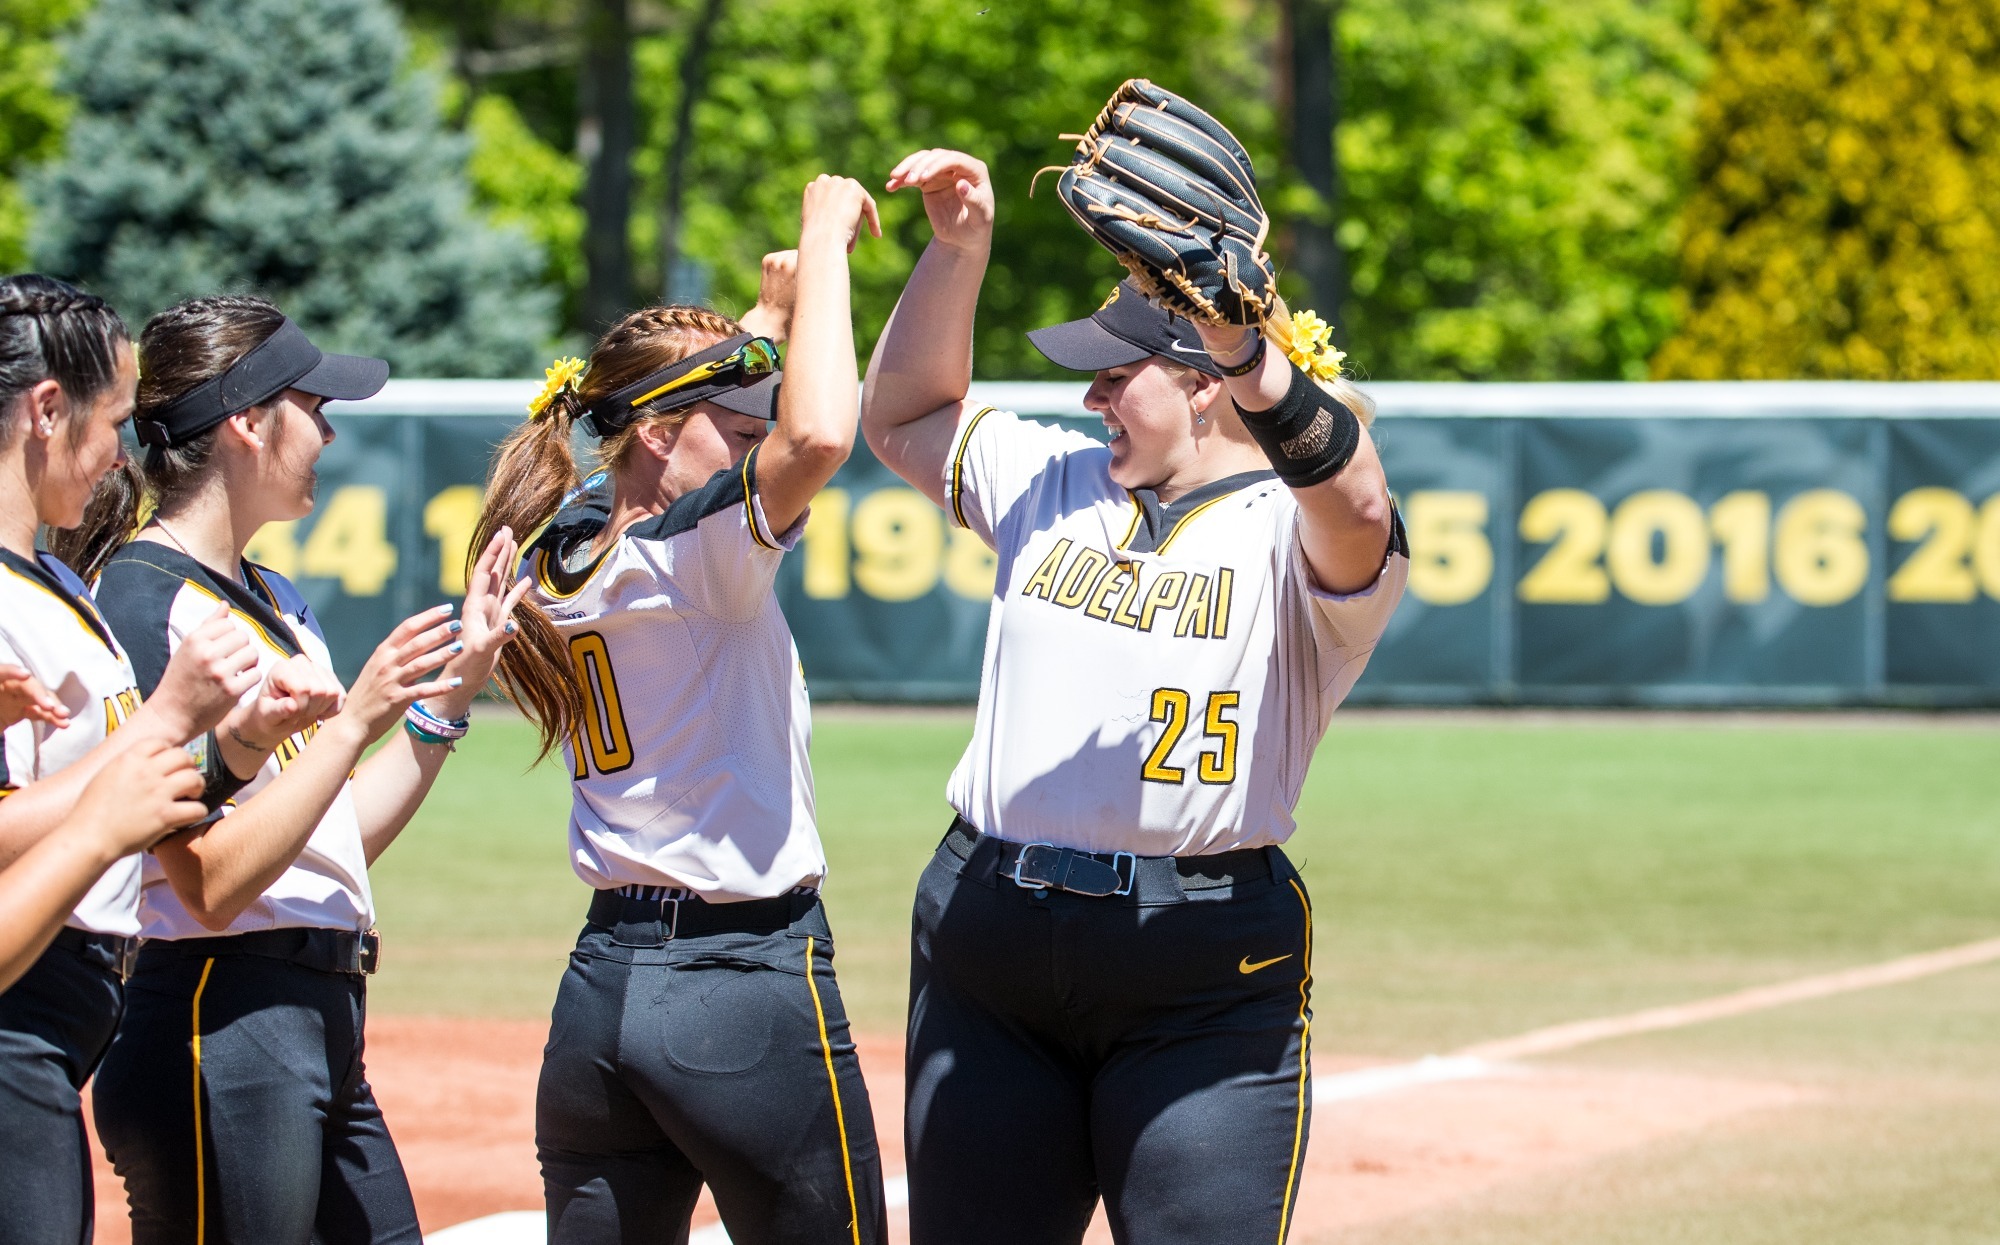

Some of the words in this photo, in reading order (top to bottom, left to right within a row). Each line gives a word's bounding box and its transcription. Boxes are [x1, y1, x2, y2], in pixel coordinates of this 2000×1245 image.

[1021, 537, 1235, 640] ADELPHI
[1517, 487, 1870, 606] 2016
[1887, 486, 2000, 604] 2
[1139, 686, 1241, 786] 25
